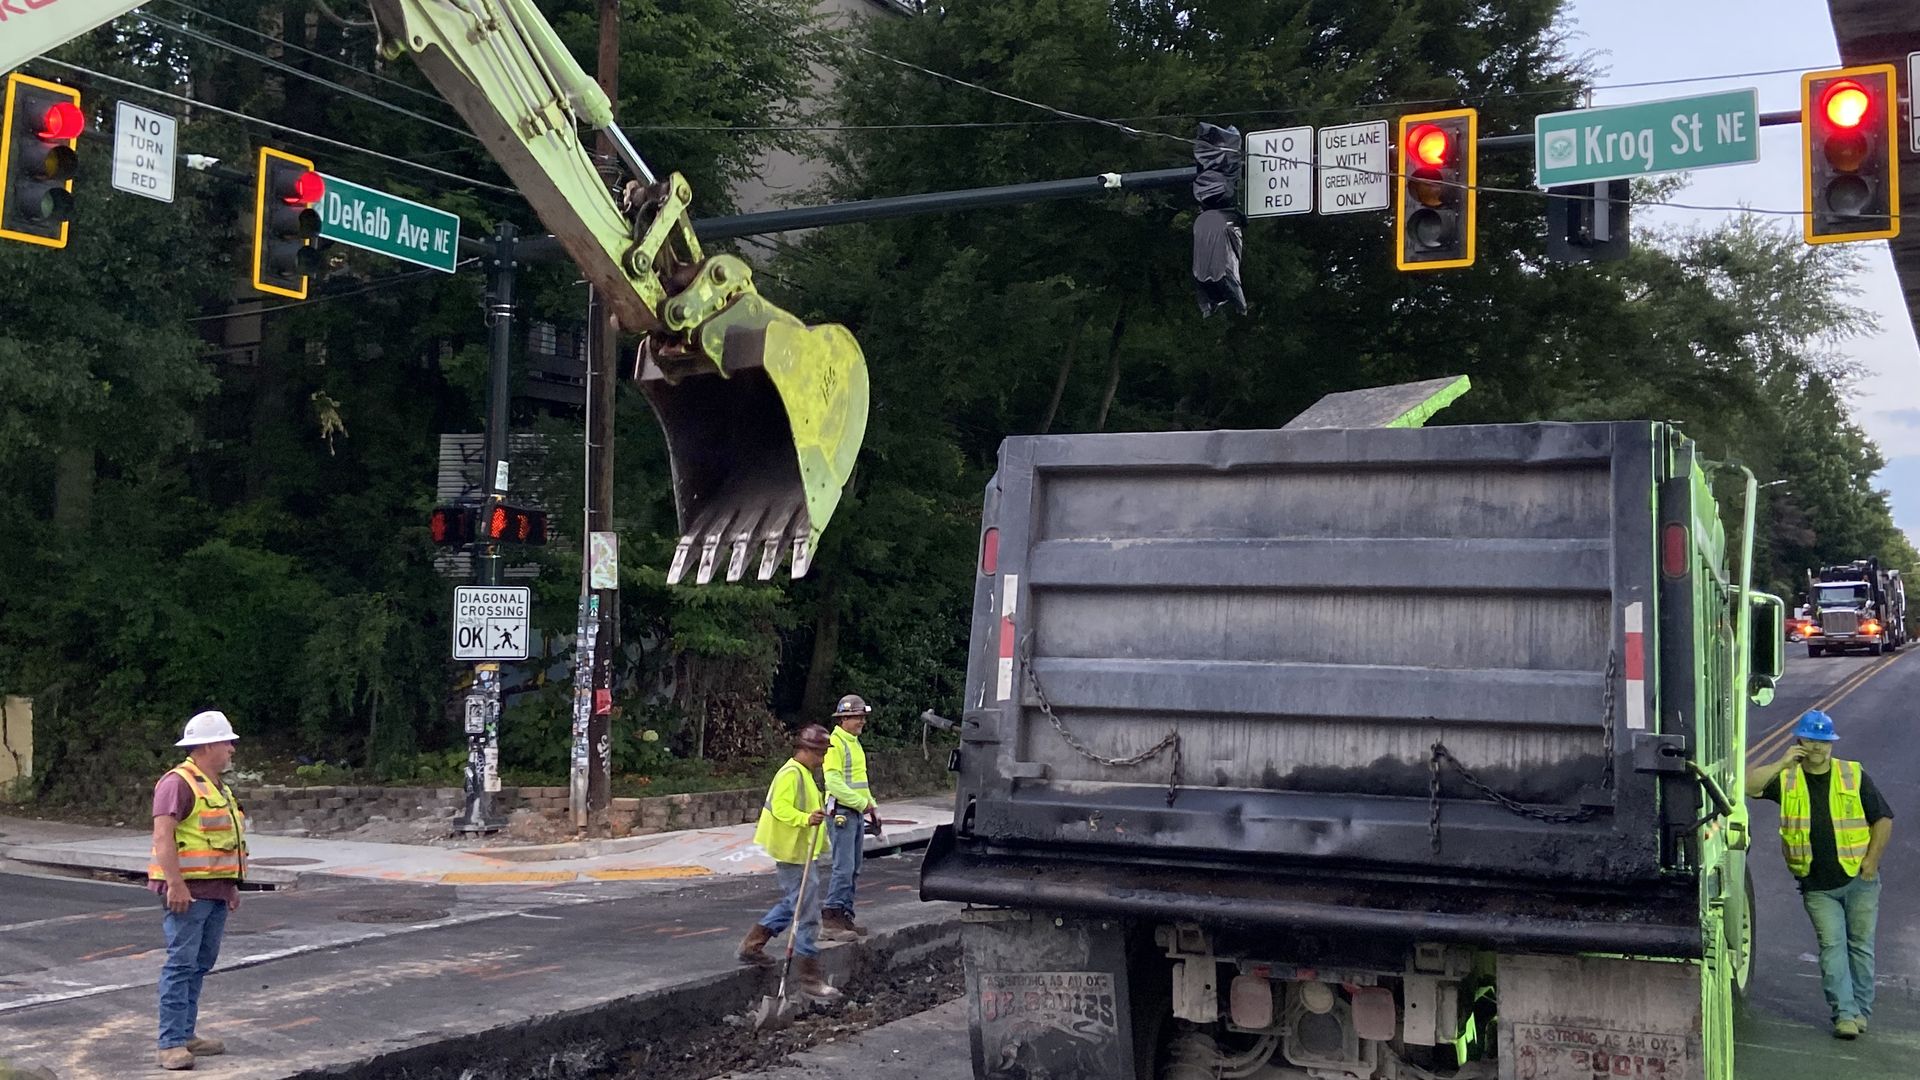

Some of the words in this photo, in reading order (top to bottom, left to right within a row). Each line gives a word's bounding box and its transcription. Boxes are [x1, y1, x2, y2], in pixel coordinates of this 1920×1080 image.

[134, 115, 160, 136] NO
[129, 134, 163, 155] TURN
[1265, 137, 1294, 154] NO
[1325, 135, 1347, 149] USE
[1351, 131, 1380, 146] LANE
[1584, 125, 1654, 171] Krog
[1670, 112, 1704, 155] St
[1716, 111, 1747, 145] NE
[135, 155, 155, 170] ON
[1260, 157, 1298, 173] TURN
[1336, 152, 1367, 167] WITH
[131, 172, 157, 189] RED
[1268, 176, 1289, 190] ON
[1325, 174, 1351, 189] GREEN
[1353, 171, 1383, 187] ARROW
[1265, 194, 1293, 208] RED
[1336, 192, 1367, 207] ONLY
[328, 191, 391, 241] DeKalb
[397, 213, 430, 251] Ave
[434, 227, 450, 254] NE
[460, 592, 525, 604] DIAGONAL
[461, 605, 524, 617] CROSSING
[458, 626, 484, 648] OK
[1548, 1028, 1599, 1046] STRONG
[1604, 1033, 1621, 1048] AS
